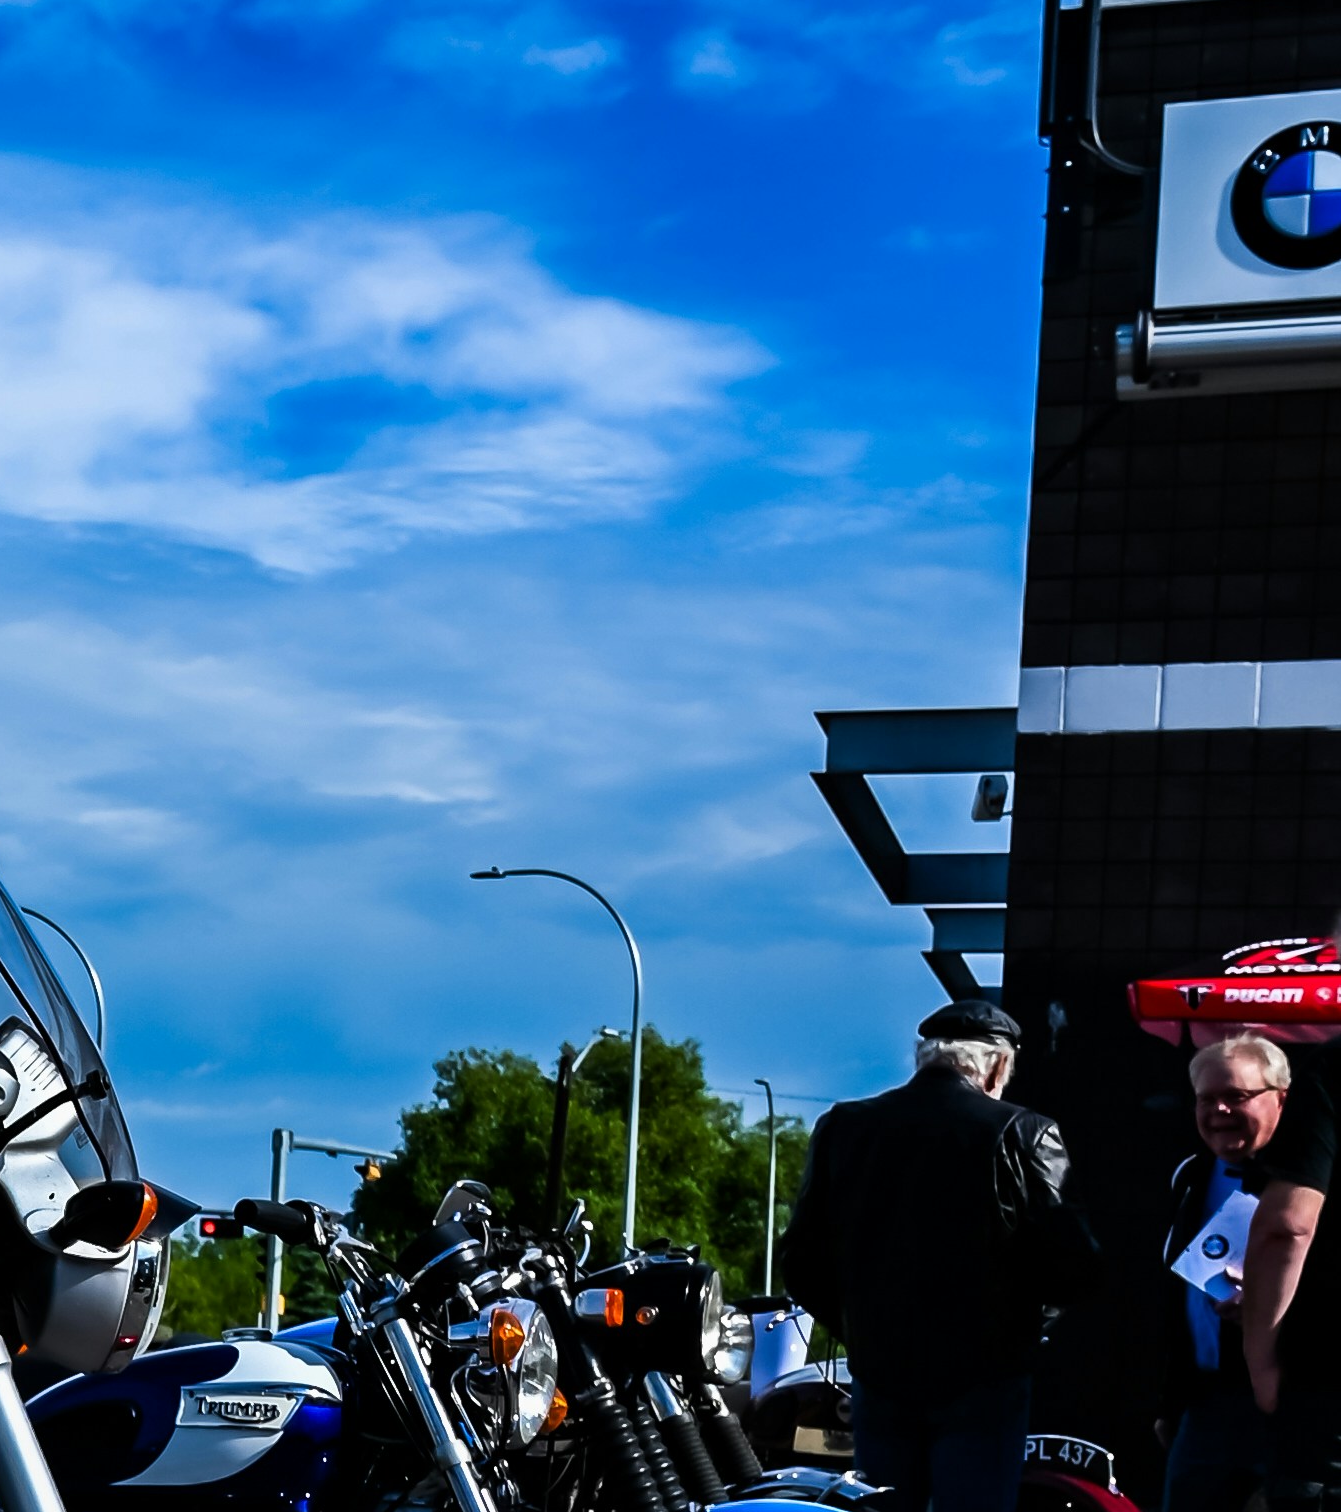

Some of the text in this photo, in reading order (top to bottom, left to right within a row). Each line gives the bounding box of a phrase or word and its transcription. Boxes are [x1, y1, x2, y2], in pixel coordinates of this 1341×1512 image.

[1224, 988, 1304, 1003] DUCATI
[194, 1395, 281, 1423] TRIUMPH
[1058, 1441, 1097, 1468] 437
